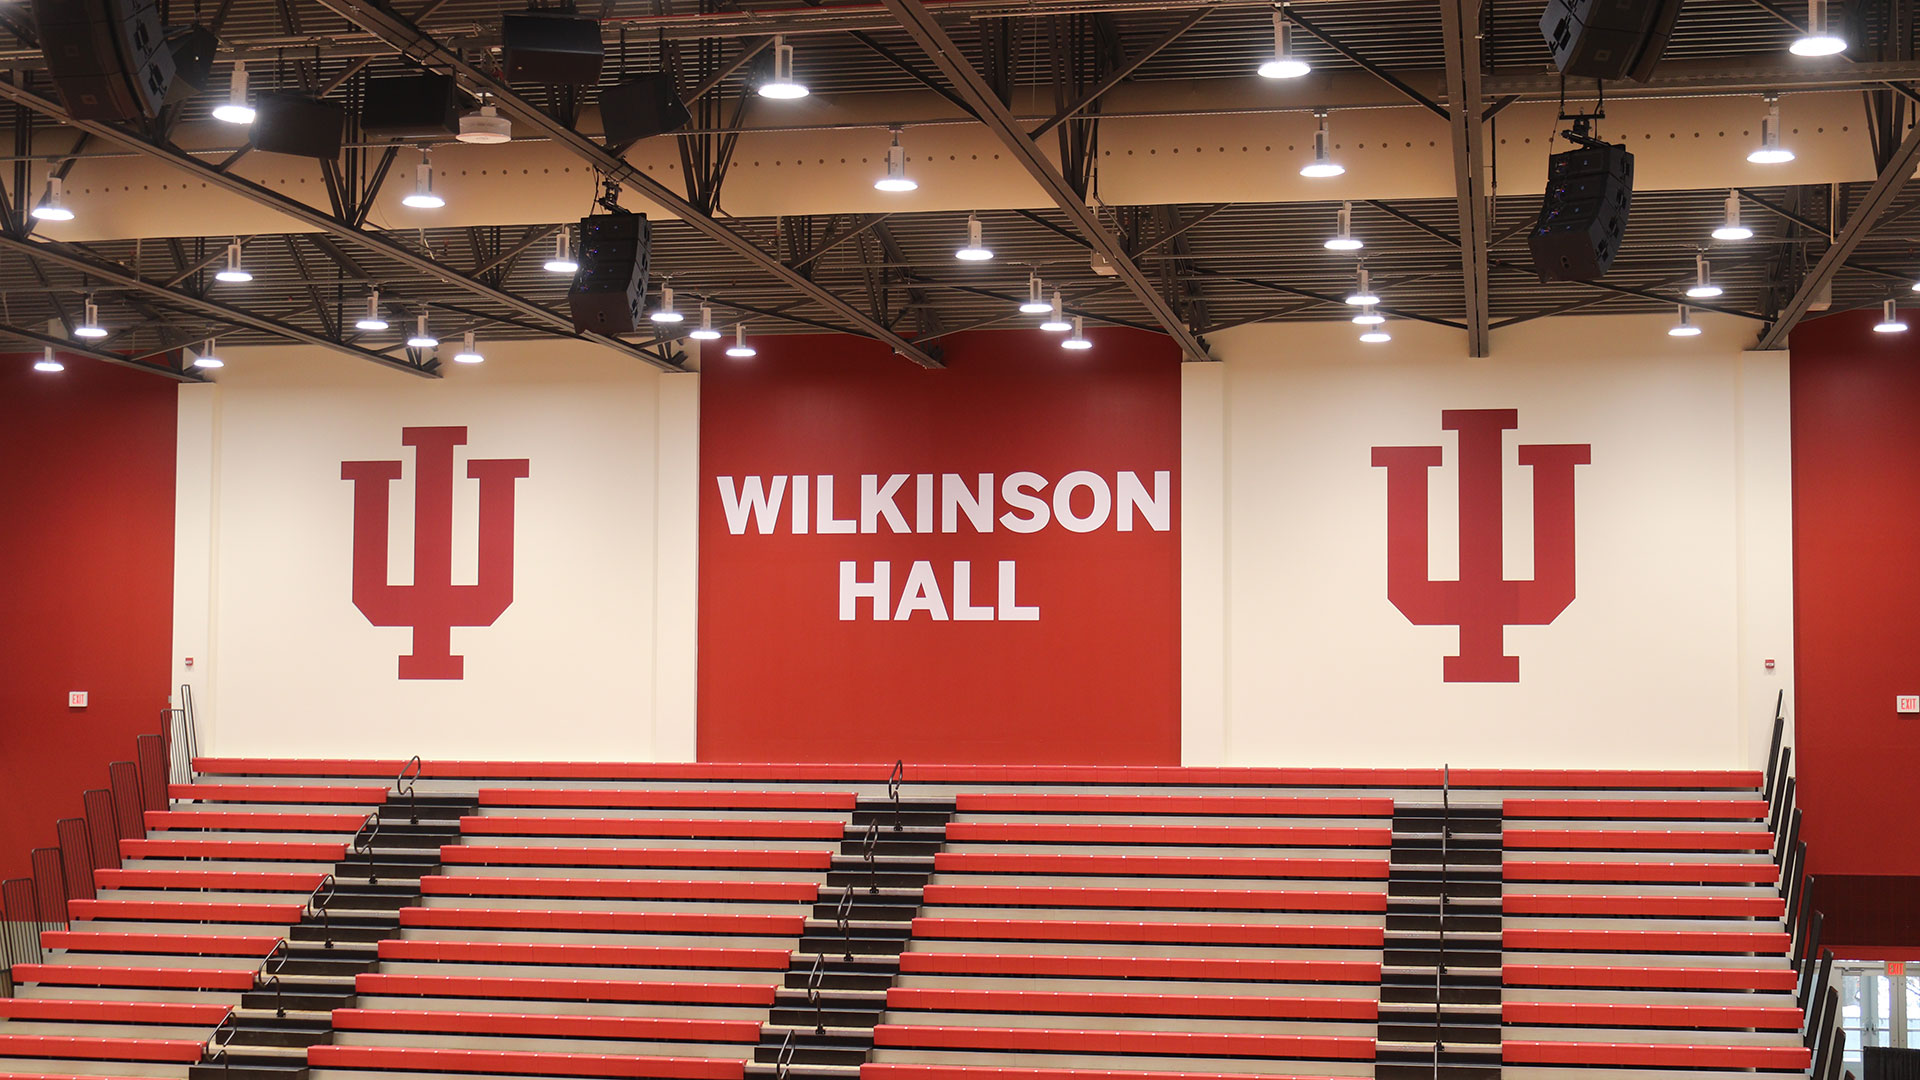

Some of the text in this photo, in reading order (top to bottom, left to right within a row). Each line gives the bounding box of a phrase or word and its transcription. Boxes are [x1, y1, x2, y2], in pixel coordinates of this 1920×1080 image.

[716, 470, 1172, 535] WILKINSON
[838, 560, 1041, 622] HALL
[72, 694, 84, 704] EXIT
[1901, 698, 1917, 710] EXIT
[1888, 963, 1904, 975] EXIT
